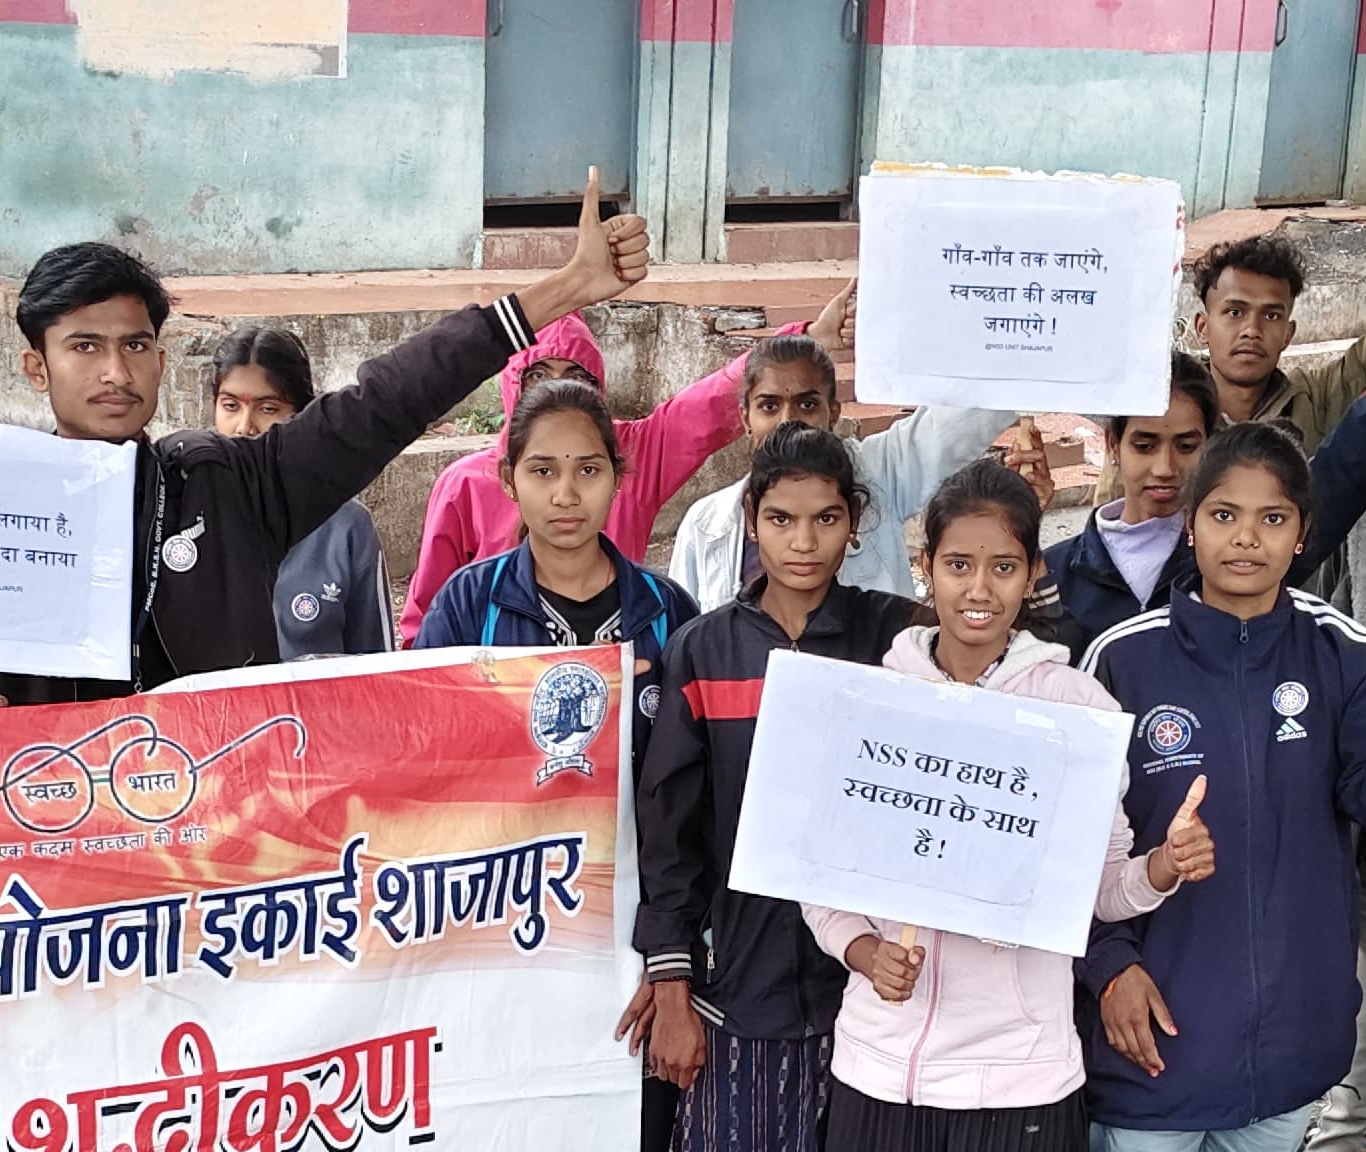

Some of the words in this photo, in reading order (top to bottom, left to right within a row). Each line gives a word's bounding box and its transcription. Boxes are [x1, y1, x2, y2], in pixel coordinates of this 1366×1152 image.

[1020, 251, 1047, 267] तक
[1053, 247, 1108, 274] जाएंगे,
[949, 283, 1017, 305] स्वच्छता
[1022, 282, 1044, 305] की
[1049, 288, 1098, 307] अलख
[54, 513, 73, 538] है,
[24, 548, 79, 569] बनाया
[857, 738, 908, 768] NSS
[914, 751, 953, 778] का
[956, 761, 1006, 790] हाथ
[21, 777, 78, 804] स्वच्छ
[127, 771, 177, 794] भारत
[843, 777, 945, 817] स्वच्छता
[949, 794, 979, 824] के
[982, 808, 1040, 839] साथ
[31, 838, 73, 858] कदम
[83, 832, 146, 856] स्वच्छता
[153, 822, 175, 846] की
[180, 824, 208, 845] ओर
[198, 835, 366, 979] इकाई
[373, 836, 586, 951] शाजापुर
